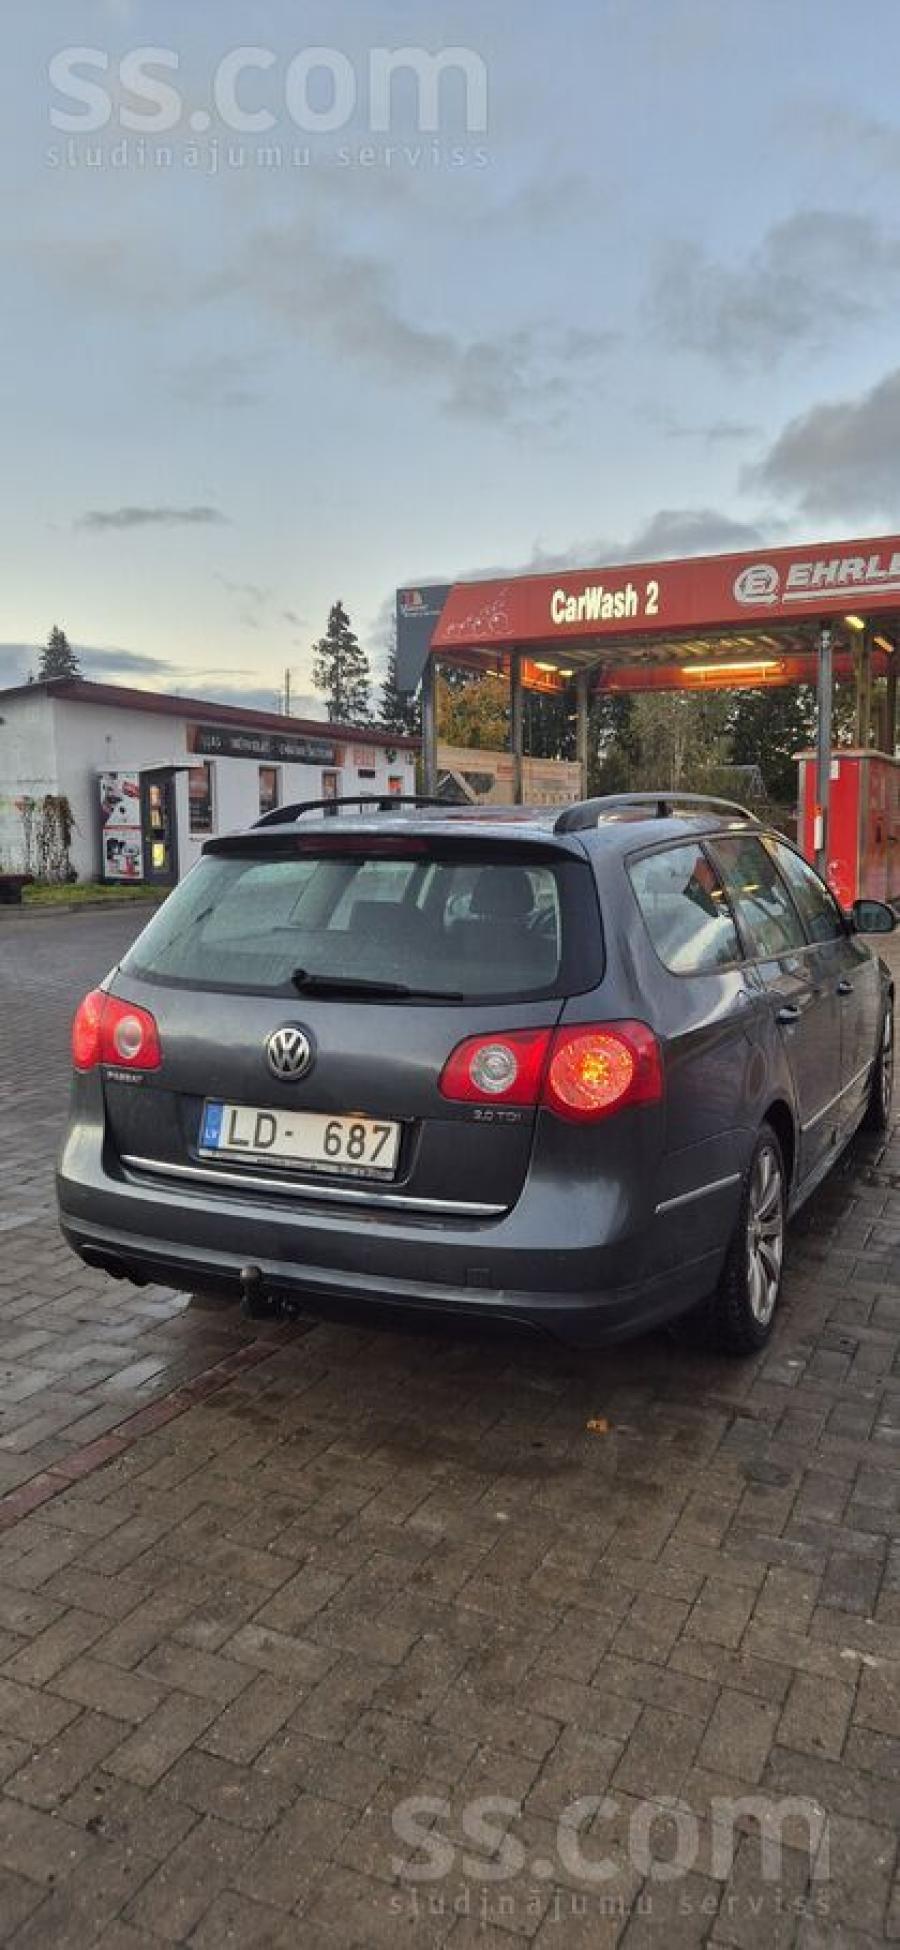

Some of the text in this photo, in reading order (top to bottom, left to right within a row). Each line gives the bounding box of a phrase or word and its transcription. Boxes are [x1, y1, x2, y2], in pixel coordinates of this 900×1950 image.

[551, 580, 659, 624] CarWash 2
[323, 1120, 392, 1162] 687
